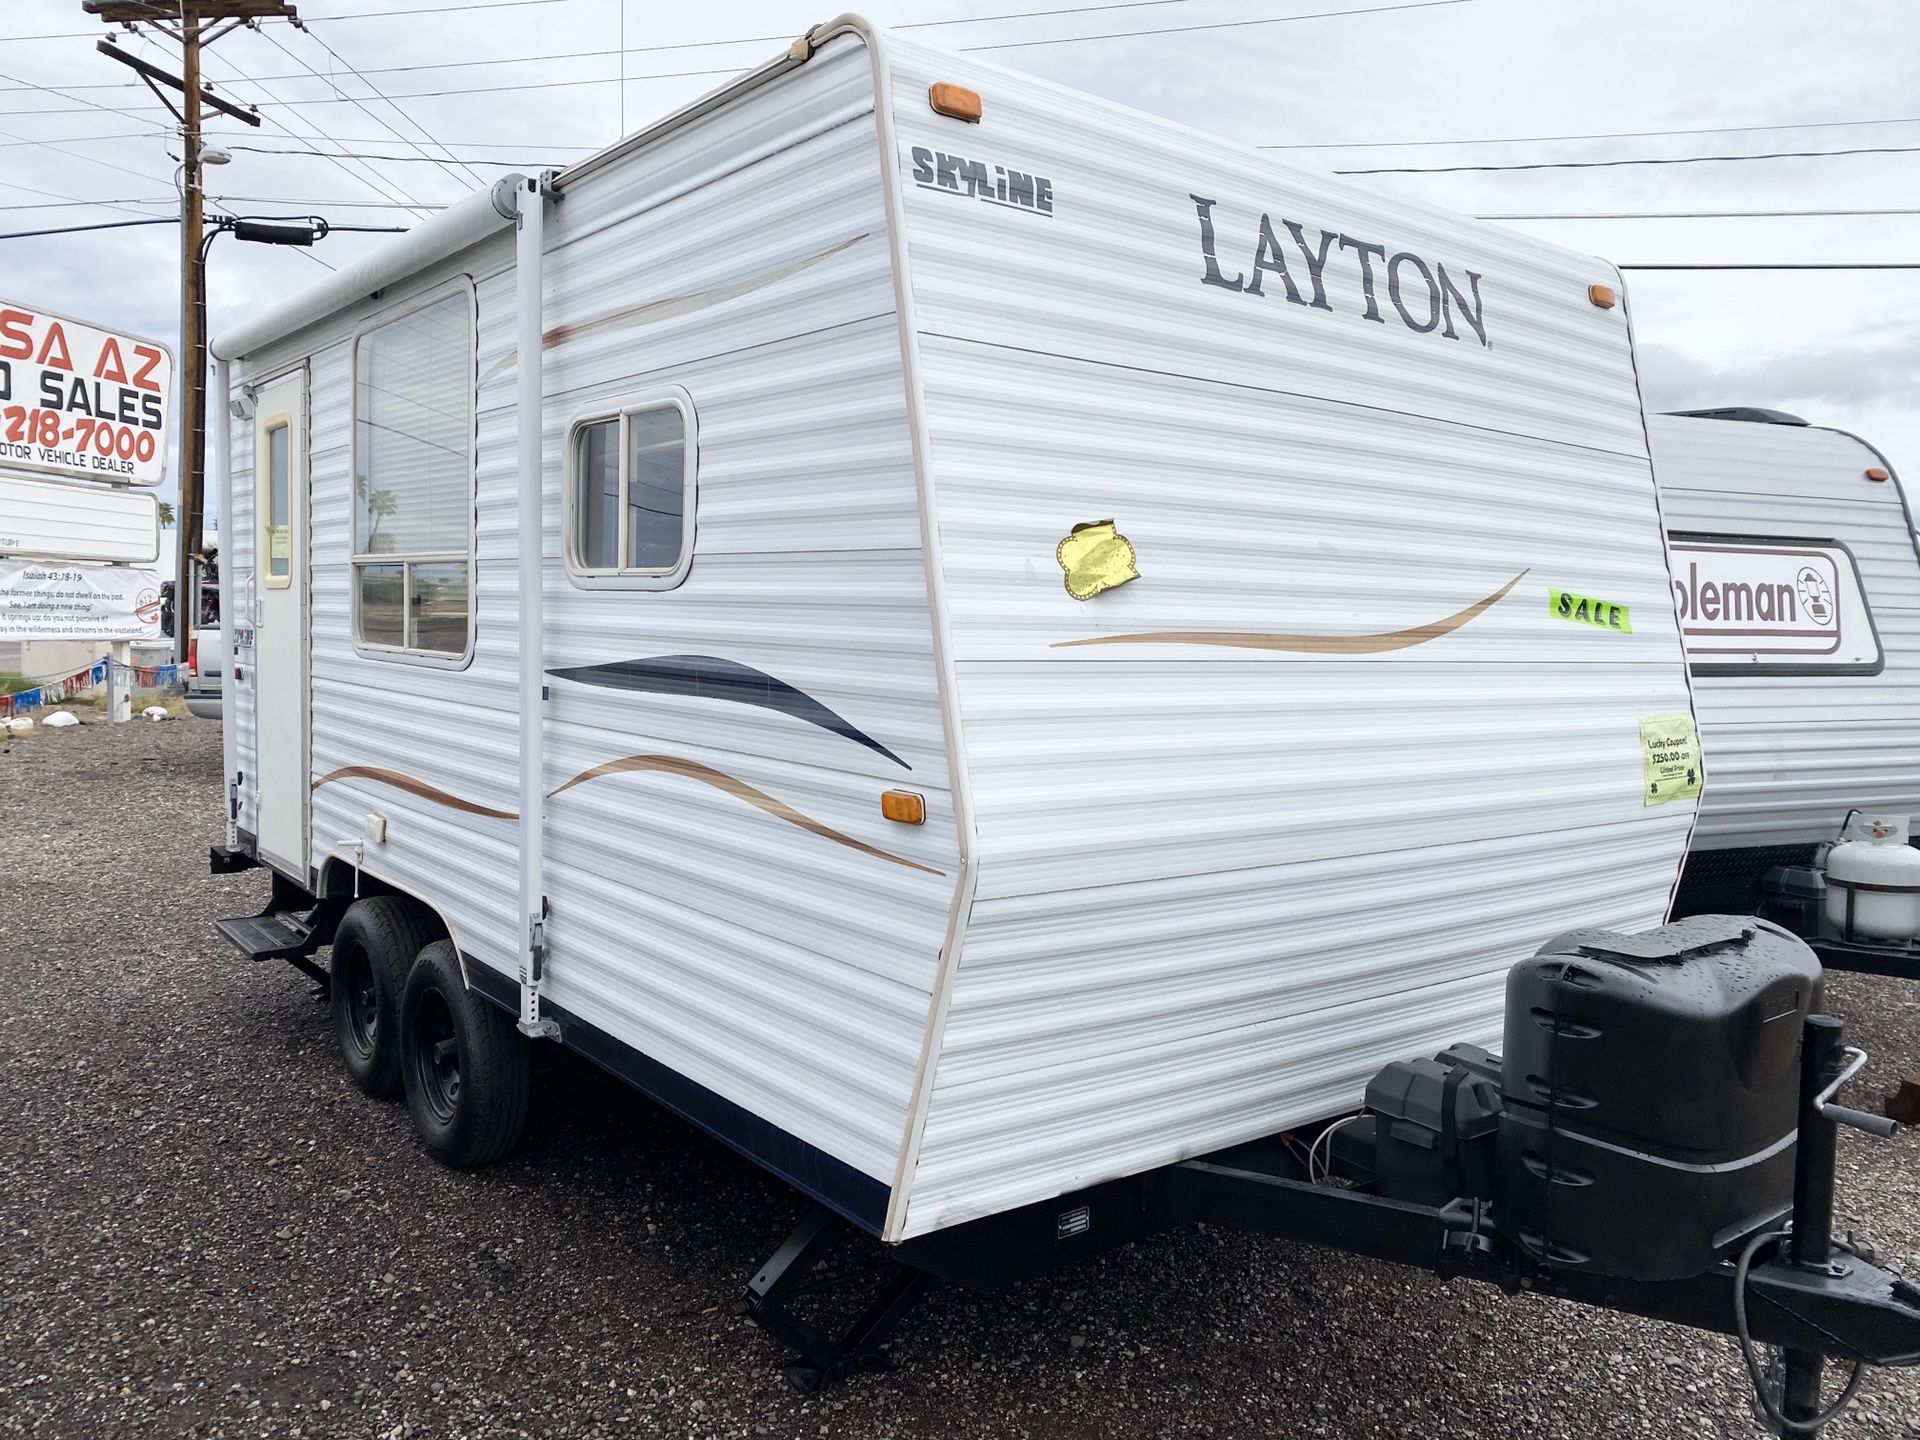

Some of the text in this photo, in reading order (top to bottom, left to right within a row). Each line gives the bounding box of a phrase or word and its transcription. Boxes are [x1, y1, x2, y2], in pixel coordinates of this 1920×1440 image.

[1190, 194, 1487, 346] LAYTON
[93, 337, 161, 393] AZ
[40, 370, 162, 430] SALES
[38, 447, 87, 468] VEHICLE
[92, 456, 135, 475] DEALER
[23, 570, 47, 580] Isaiah
[11, 588, 33, 597] former
[56, 590, 64, 598] do
[65, 591, 74, 599] not
[76, 591, 92, 600] dwell
[38, 602, 55, 612] doing
[1558, 592, 1622, 628] SALE
[1648, 740, 1665, 749] Lucky
[1652, 751, 1680, 764] $250.00
